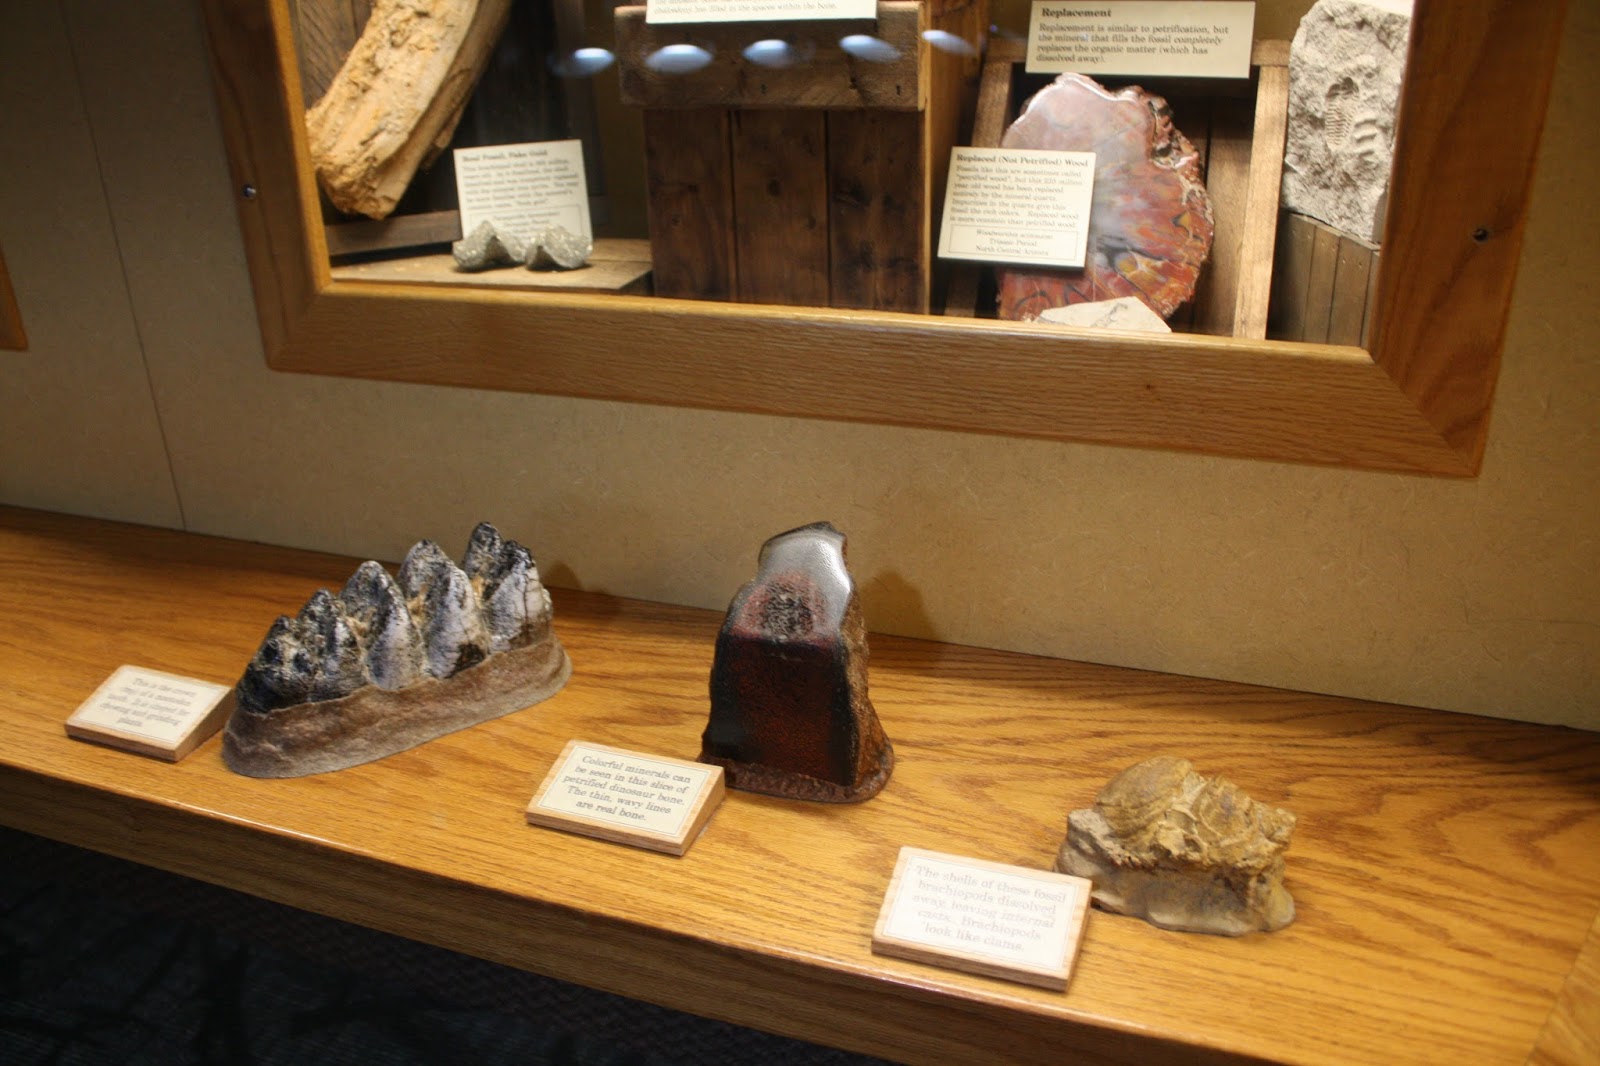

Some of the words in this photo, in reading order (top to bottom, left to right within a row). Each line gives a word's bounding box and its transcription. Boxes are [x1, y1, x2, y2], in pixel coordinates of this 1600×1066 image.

[1042, 8, 1112, 18] Replacement
[1038, 33, 1053, 41] the
[1054, 33, 1089, 42] mineral
[1091, 34, 1109, 42] that
[1111, 34, 1129, 42] fills
[1131, 34, 1146, 43] the
[1148, 34, 1172, 43] fossil
[1174, 35, 1223, 46] completely
[1039, 23, 1095, 33] Replacement
[1097, 24, 1105, 32] is
[1107, 24, 1139, 33] similar
[1140, 25, 1150, 33] to
[1152, 24, 1210, 35] petrification,
[1213, 25, 1229, 34] but
[1035, 54, 1075, 62] dissolved
[1037, 44, 1072, 54] replaces
[1074, 44, 1090, 52] the
[1091, 45, 1124, 54] organic
[1126, 45, 1157, 54] matter
[1159, 45, 1190, 56] (which
[1192, 45, 1209, 54] has
[956, 154, 996, 164] Replaced
[998, 155, 1018, 165] (Not
[1020, 156, 1063, 167] Petrified)
[1065, 159, 1089, 168] Wood
[574, 765, 587, 774] be
[588, 769, 612, 780] seen
[614, 772, 626, 782] in
[628, 774, 648, 786] this
[650, 780, 675, 792] slice
[676, 785, 690, 794] of
[582, 755, 624, 770] Colorful
[625, 765, 671, 780] minerals
[672, 774, 692, 784] can
[563, 774, 608, 790] petrified
[609, 782, 656, 799] dinosaur
[657, 792, 686, 806] bone.
[567, 785, 588, 797] The
[589, 790, 613, 803] thin,
[616, 797, 644, 810] wavy
[645, 801, 672, 814] lines
[575, 800, 594, 810] are
[595, 804, 617, 816] real
[618, 808, 647, 822] bone.
[915, 864, 940, 880] The
[942, 871, 978, 887] shells
[980, 878, 995, 889] of
[997, 881, 1031, 897] these
[1033, 887, 1067, 904] fossil
[918, 879, 994, 903] brachiopods
[996, 894, 1057, 915] dissolved
[951, 901, 998, 920] leaving
[1000, 911, 1056, 929] internal
[960, 915, 1042, 940] Brachiopods
[924, 921, 953, 938] look
[955, 927, 981, 943] like
[982, 935, 1025, 952] clams.
